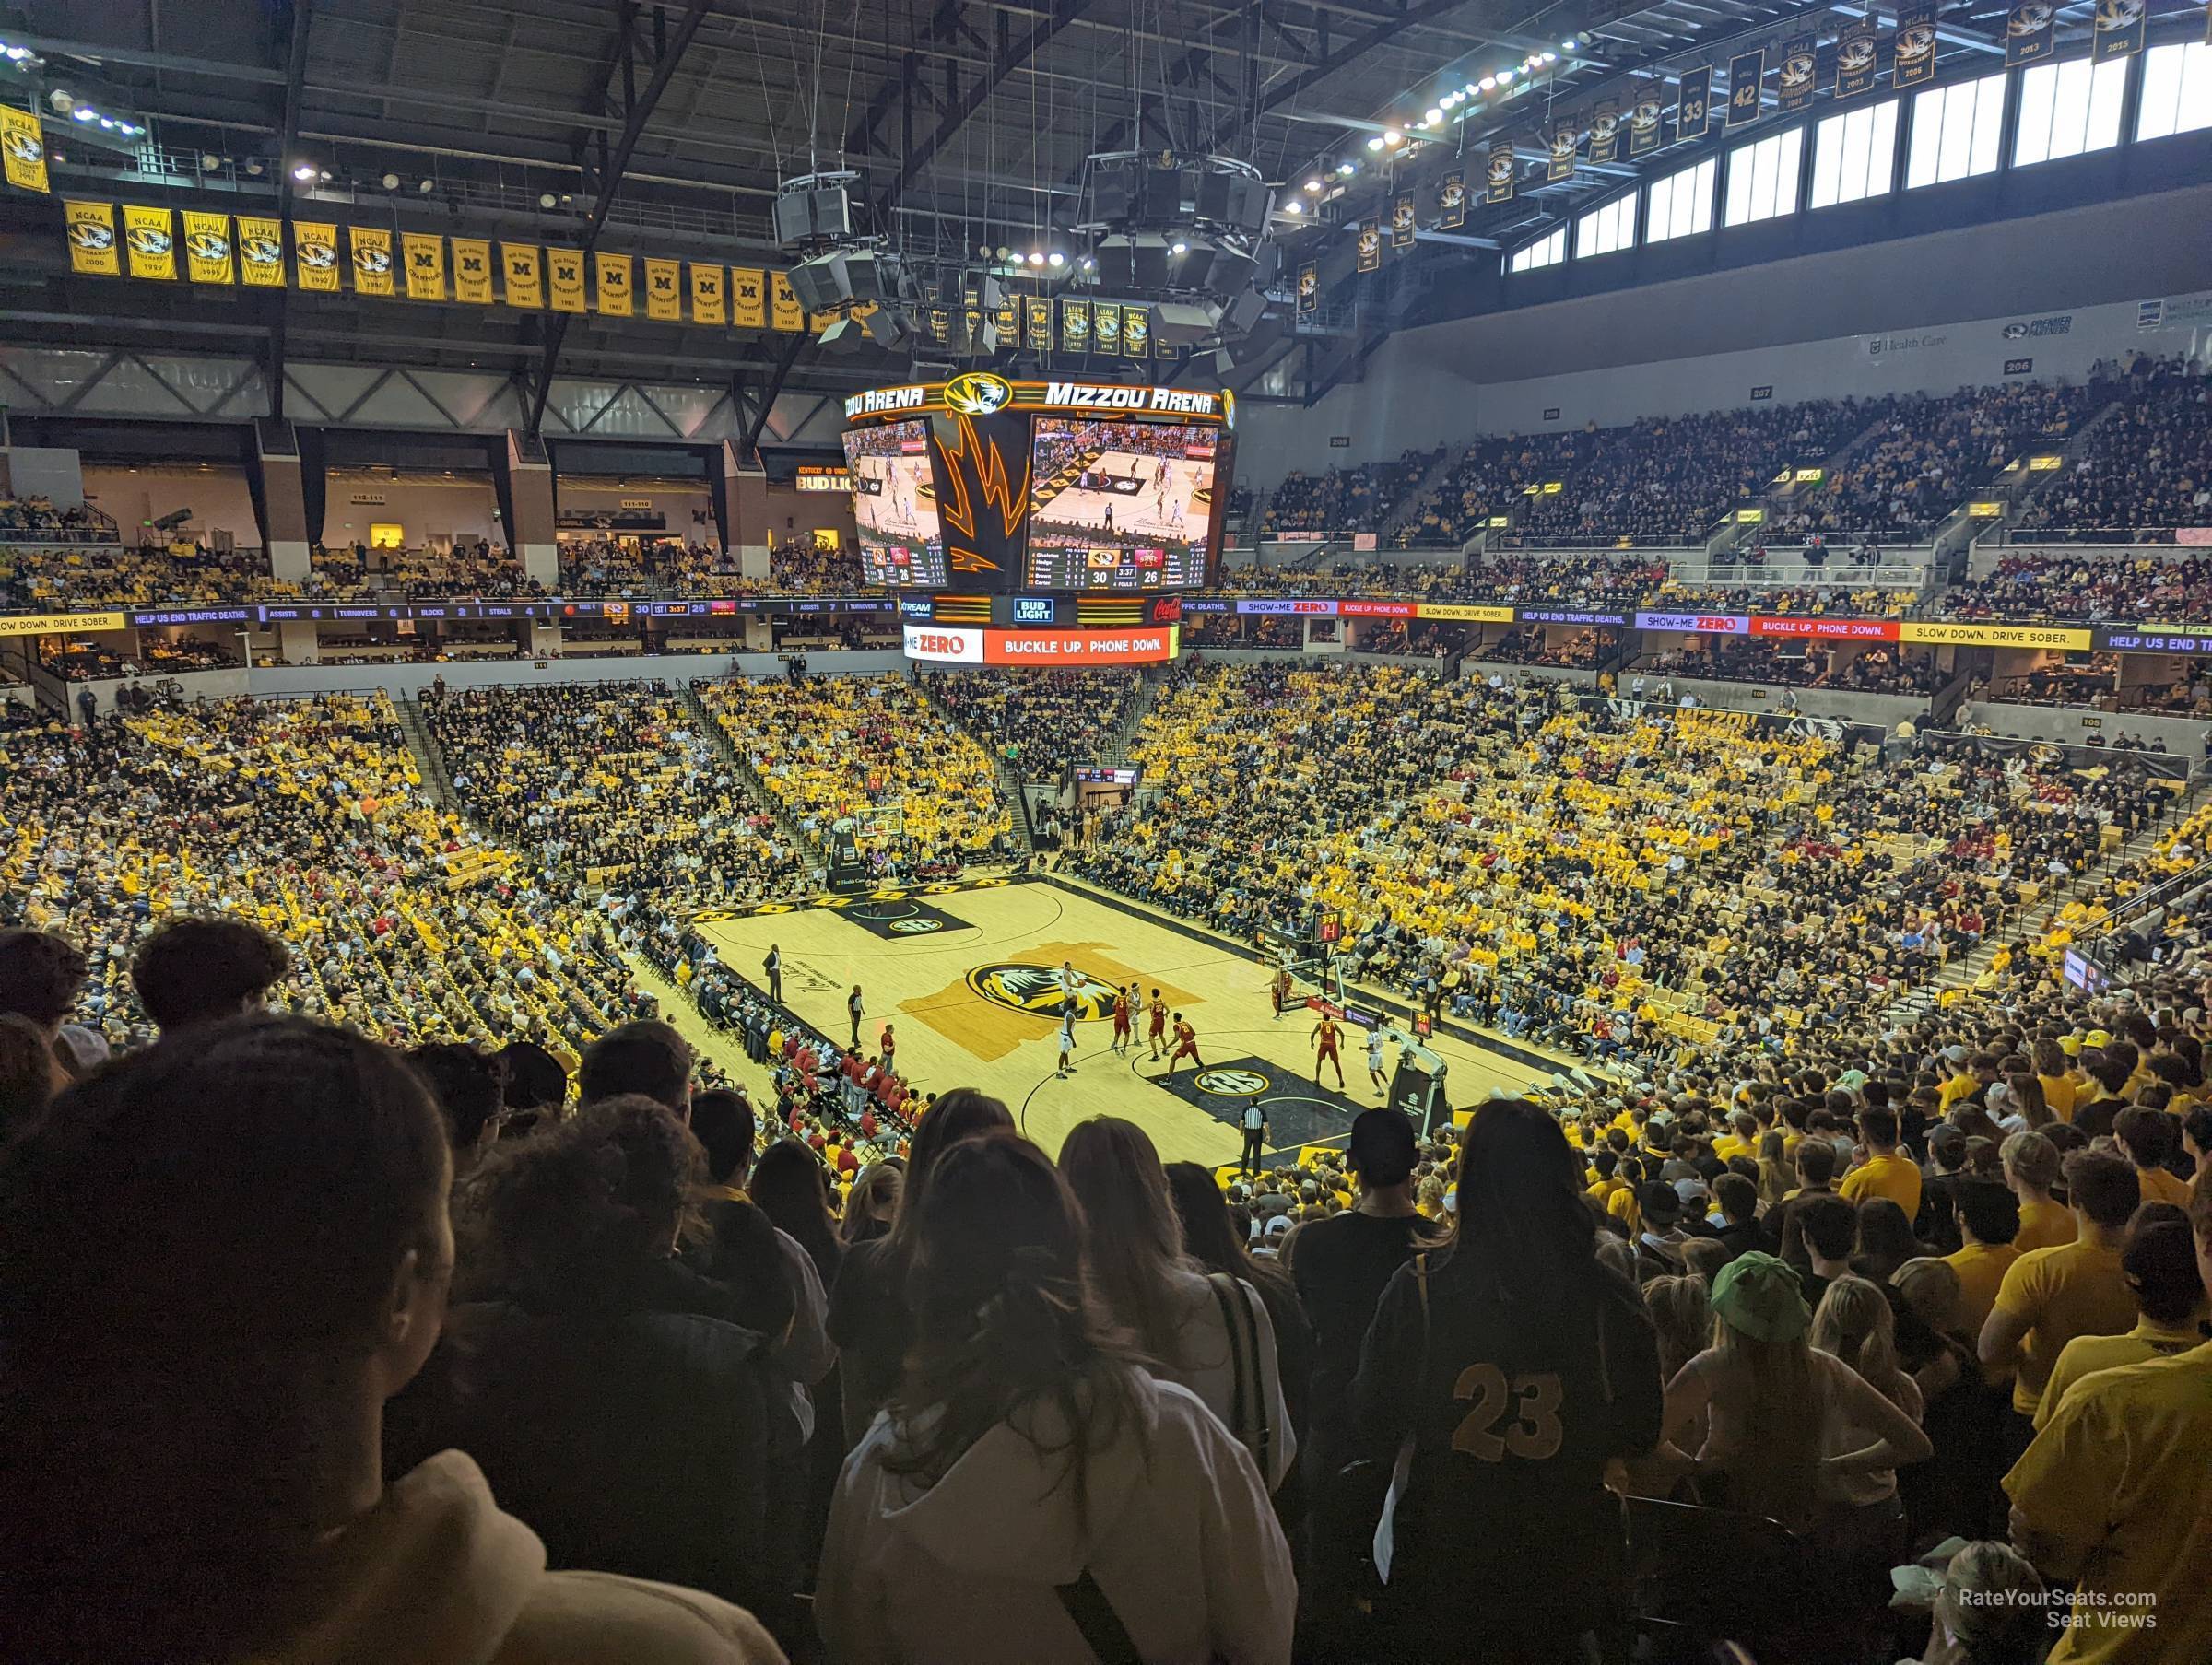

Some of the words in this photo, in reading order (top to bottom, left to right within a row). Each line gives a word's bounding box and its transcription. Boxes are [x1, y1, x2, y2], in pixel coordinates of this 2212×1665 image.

[1733, 85, 1756, 108] 42
[1683, 100, 1703, 123] 33
[8, 118, 31, 131] NCAA
[76, 211, 103, 222] NCAA
[135, 217, 162, 228] NCAA
[194, 223, 221, 233] NCAA
[247, 227, 275, 237] NCAA
[302, 232, 329, 243] NCAA
[359, 238, 384, 248] NCAA
[415, 252, 434, 268] M
[463, 257, 482, 272] M
[512, 262, 531, 276] M
[557, 267, 576, 280] M
[605, 271, 623, 286] M
[654, 276, 672, 290] M
[699, 281, 716, 295] M
[740, 286, 757, 299] M
[779, 289, 794, 301] M
[865, 387, 924, 413] ARENA
[1045, 382, 1147, 407] MIZZOU
[1150, 388, 1213, 413] ARENA
[796, 476, 830, 490] BUD
[900, 569, 909, 580] 26
[1093, 571, 1107, 583] 30
[1145, 571, 1158, 583] 26
[635, 605, 649, 614] 30
[654, 605, 664, 614] 1ST
[692, 604, 705, 613] 26
[900, 603, 931, 612] XTREAM
[1021, 601, 1046, 610] BUD
[1249, 604, 1290, 612] SHOW-ME
[1293, 603, 1329, 613] ZERO
[135, 615, 155, 625] HELP
[157, 614, 169, 623] US
[171, 614, 185, 622] END
[187, 612, 218, 621] TRAFFIC
[219, 610, 248, 620] DEATHS.
[269, 610, 297, 618] ASSISTS
[339, 609, 378, 617] TURNOVERS
[420, 608, 444, 616] BLOCKS
[1017, 610, 1051, 619] LIGHT
[20, 619, 49, 629] DOWN.
[54, 618, 79, 627] DRIVE
[83, 617, 111, 627] SOBER.
[1551, 613, 1564, 621] END
[1567, 614, 1593, 622] TRAFFIC
[1595, 615, 1625, 625] DEATHS.
[1648, 616, 1693, 627] SHOW-ME
[1696, 616, 1736, 631] ZERO
[1762, 621, 1796, 632] BUCKLE
[1799, 623, 1814, 633] UP.
[1818, 623, 1848, 634] PHONE
[1852, 625, 1884, 636] DOWN.
[1917, 628, 1947, 639] SLOW
[1951, 629, 1987, 640] DOWN.
[1993, 630, 2024, 641] DRIVE
[2030, 632, 2070, 643] SOBER.
[920, 634, 964, 654] ZERO
[1005, 640, 1057, 653] BUCKLE
[1064, 641, 1084, 653] UP.
[1090, 639, 1129, 652] PHONE
[1133, 639, 1161, 651] DOWN.
[2110, 635, 2141, 648] HELP
[2146, 638, 2164, 649] US
[2169, 638, 2195, 650] END
[2083, 718, 2100, 727] 105
[1322, 914, 1338, 924] 3:37
[1323, 924, 1335, 939] 14
[1417, 1014, 1429, 1023] 3:37
[1451, 1362, 1564, 1462] 23
